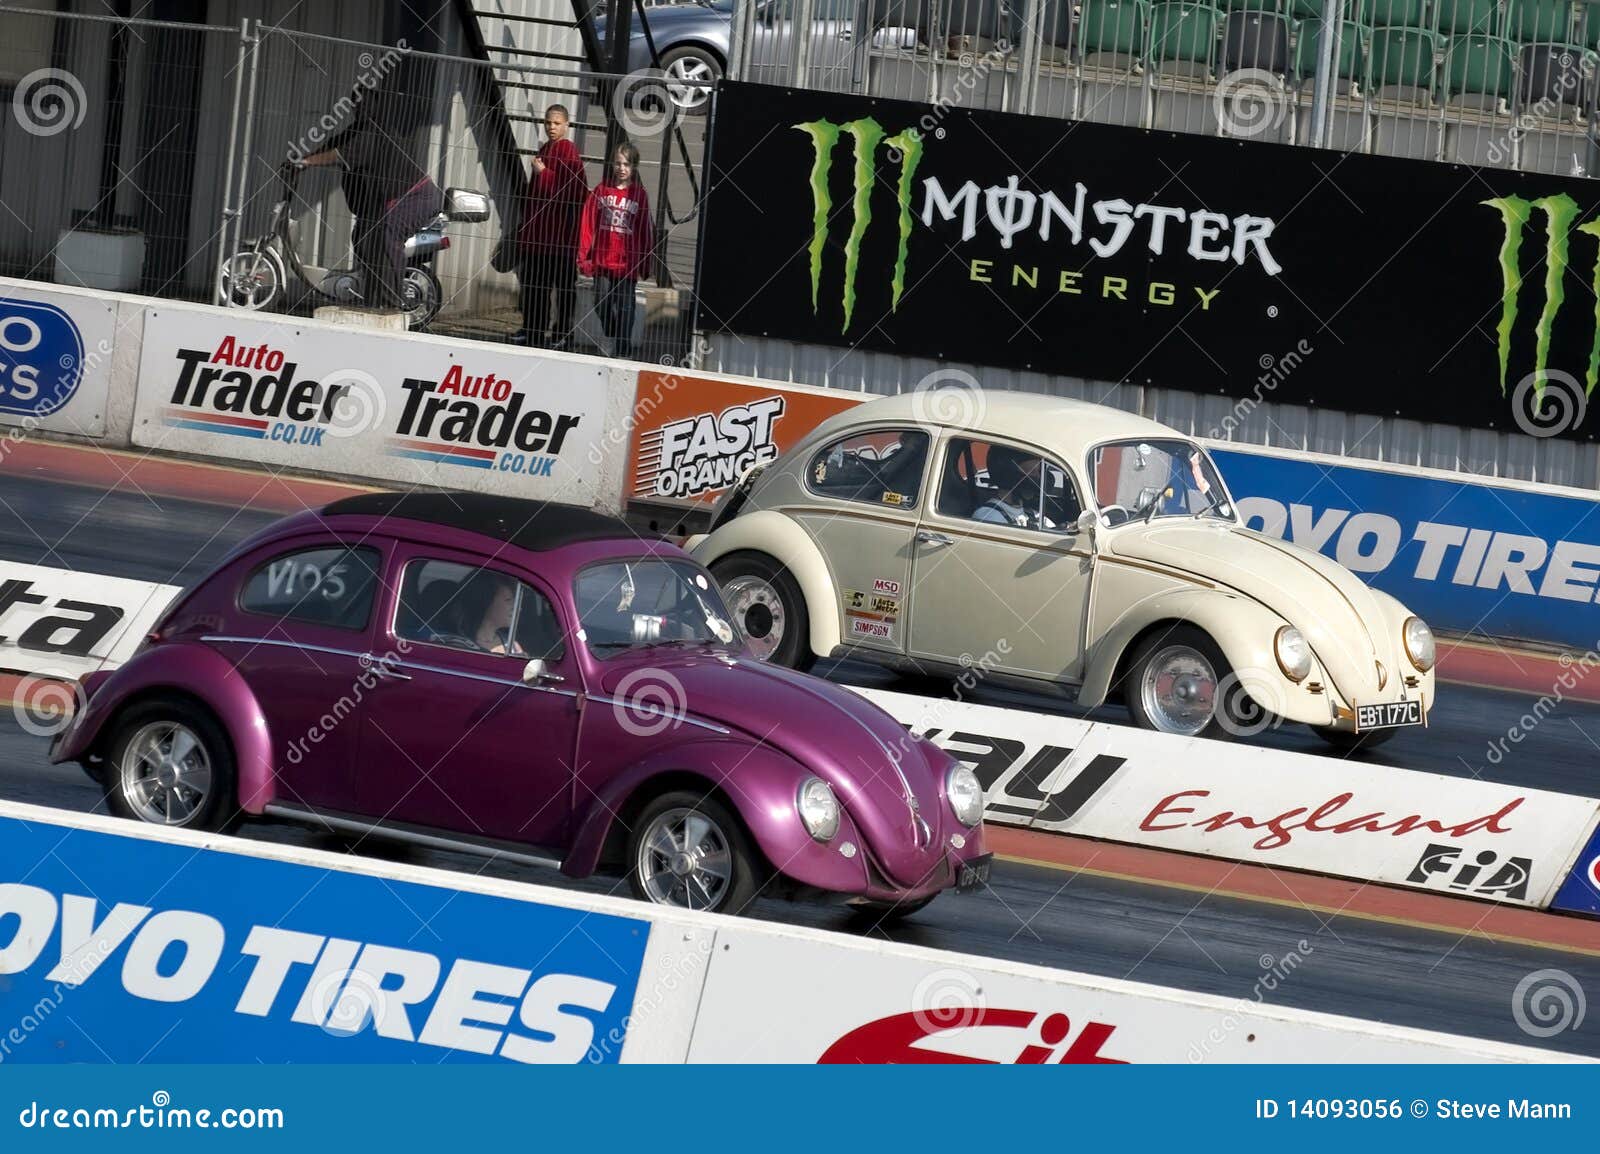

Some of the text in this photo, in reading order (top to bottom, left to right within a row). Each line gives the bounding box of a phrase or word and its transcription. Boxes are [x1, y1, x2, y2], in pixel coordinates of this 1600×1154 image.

[922, 175, 1283, 276] MONSTER
[970, 259, 1221, 310] ENERGY
[212, 335, 284, 371] Auto
[438, 365, 512, 401] Auto
[171, 349, 350, 424] Trader
[396, 378, 580, 454] Trader
[493, 452, 557, 477] .CO.UK
[660, 396, 785, 469] FAST
[874, 580, 898, 592] MSD
[1412, 520, 1600, 604] TIRE
[1358, 702, 1418, 727] EBT 177C
[901, 723, 1128, 822] ay
[1139, 790, 1526, 850] England
[235, 925, 616, 1064] TIRES
